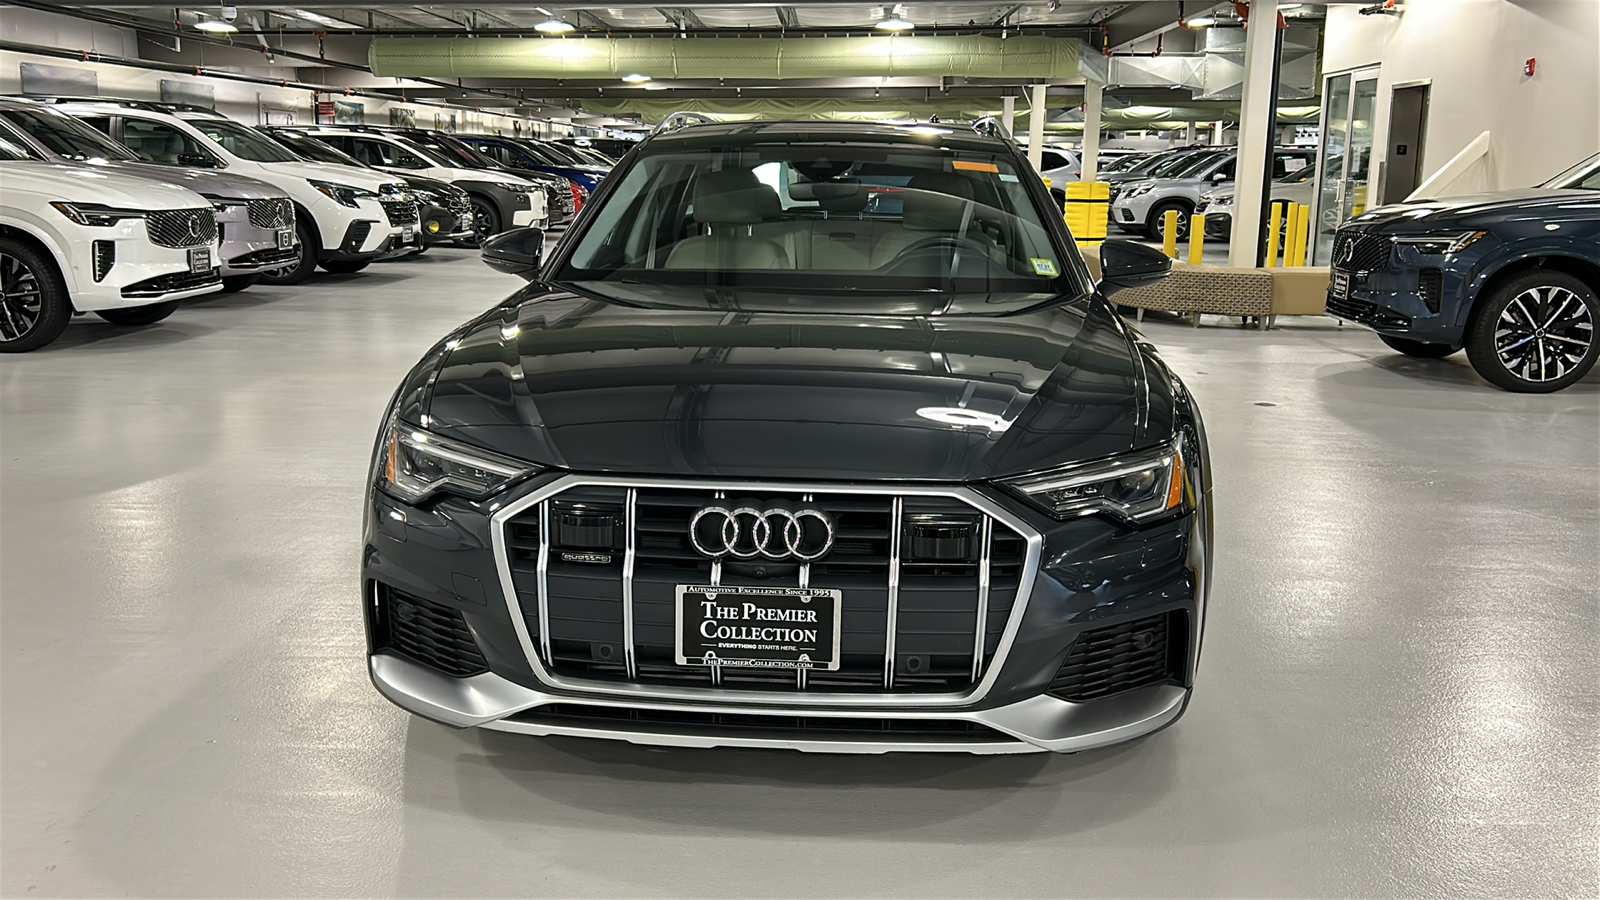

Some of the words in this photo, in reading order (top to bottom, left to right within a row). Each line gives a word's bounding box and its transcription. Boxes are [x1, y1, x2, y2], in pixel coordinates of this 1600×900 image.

[700, 601, 739, 620] THE
[742, 603, 818, 623] PREMIER
[700, 620, 817, 643] COLLECTION
